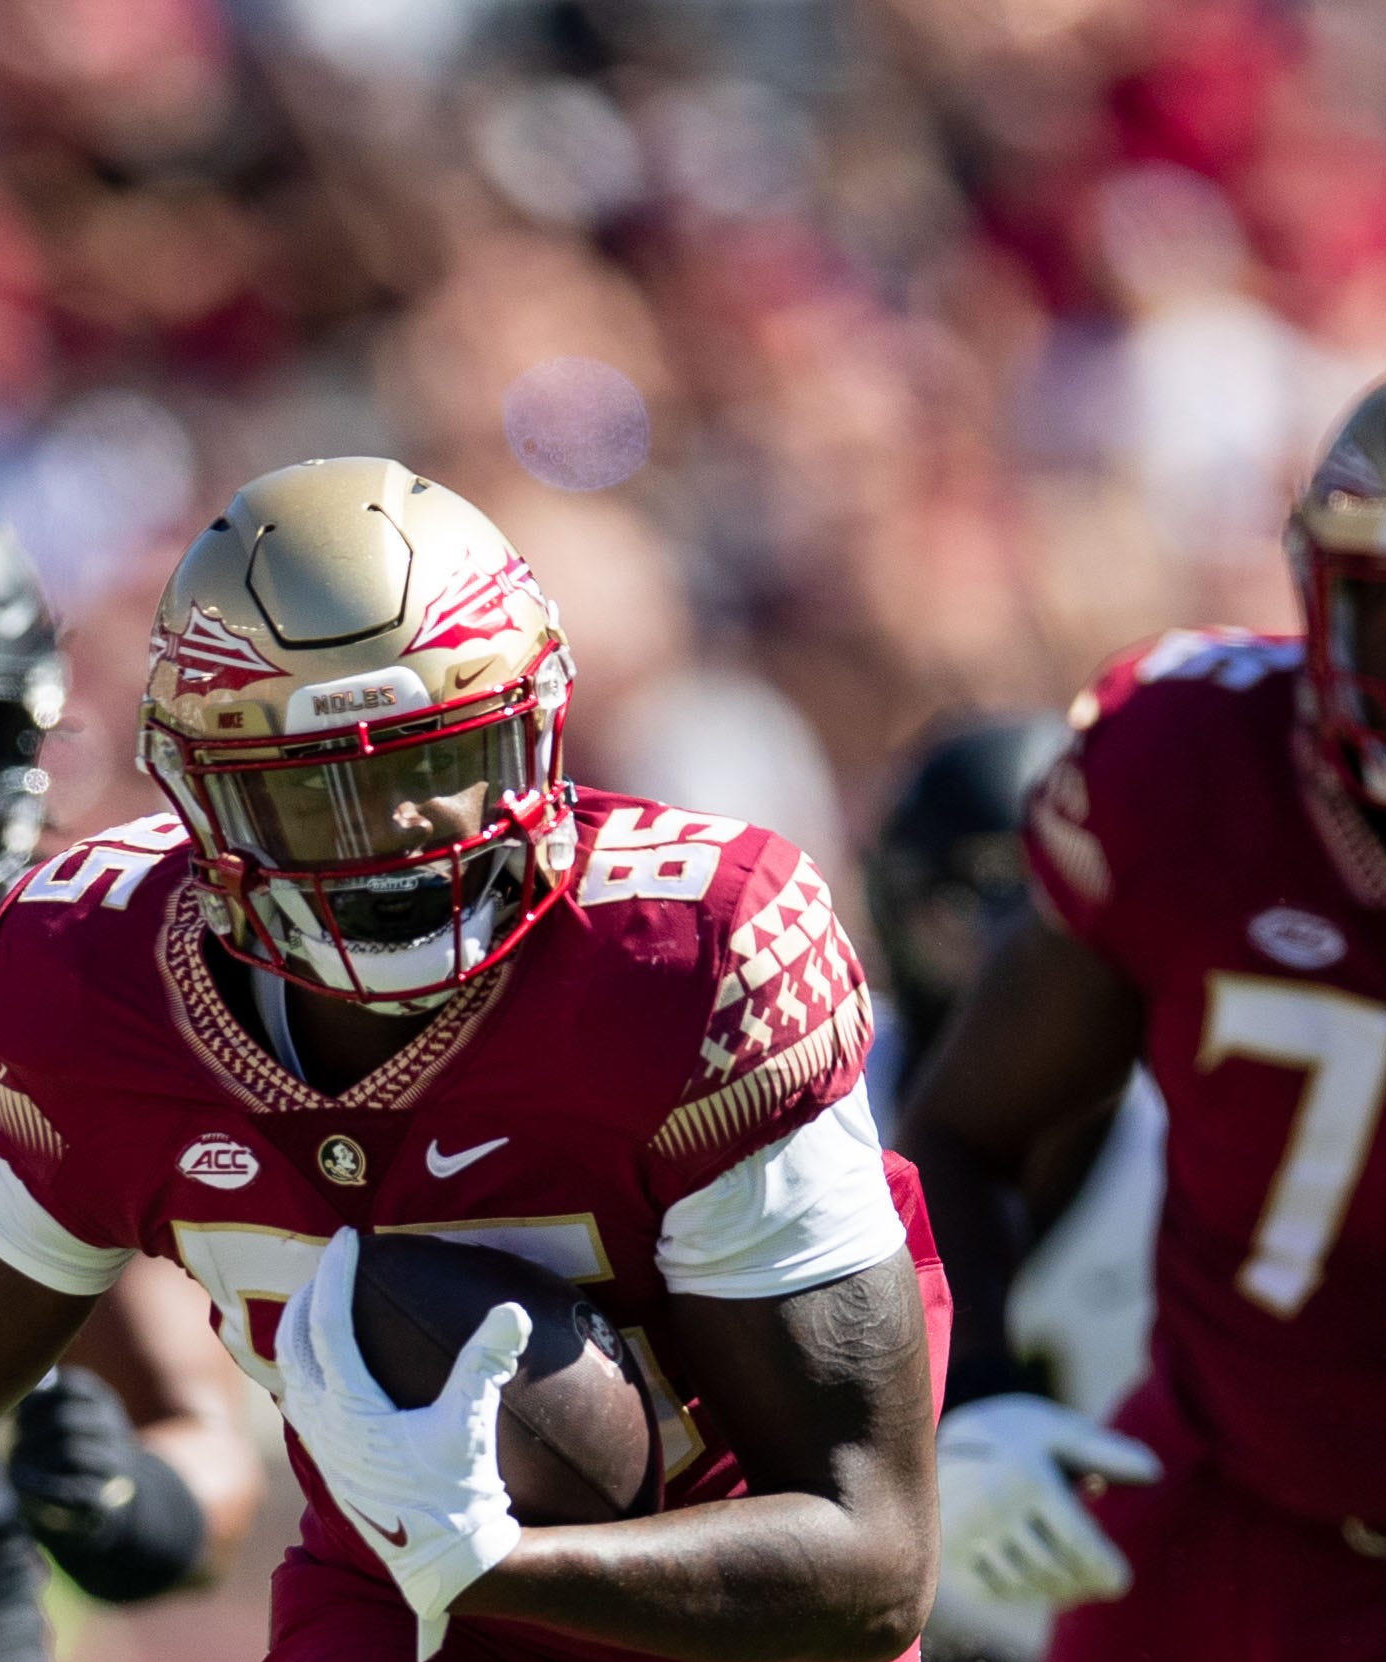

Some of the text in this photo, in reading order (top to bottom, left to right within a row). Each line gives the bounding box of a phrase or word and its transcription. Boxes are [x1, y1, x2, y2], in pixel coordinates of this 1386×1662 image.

[312, 685, 397, 716] NOLES
[218, 712, 244, 729] NIKE
[577, 806, 749, 908] 85
[191, 1150, 249, 1170] ACC
